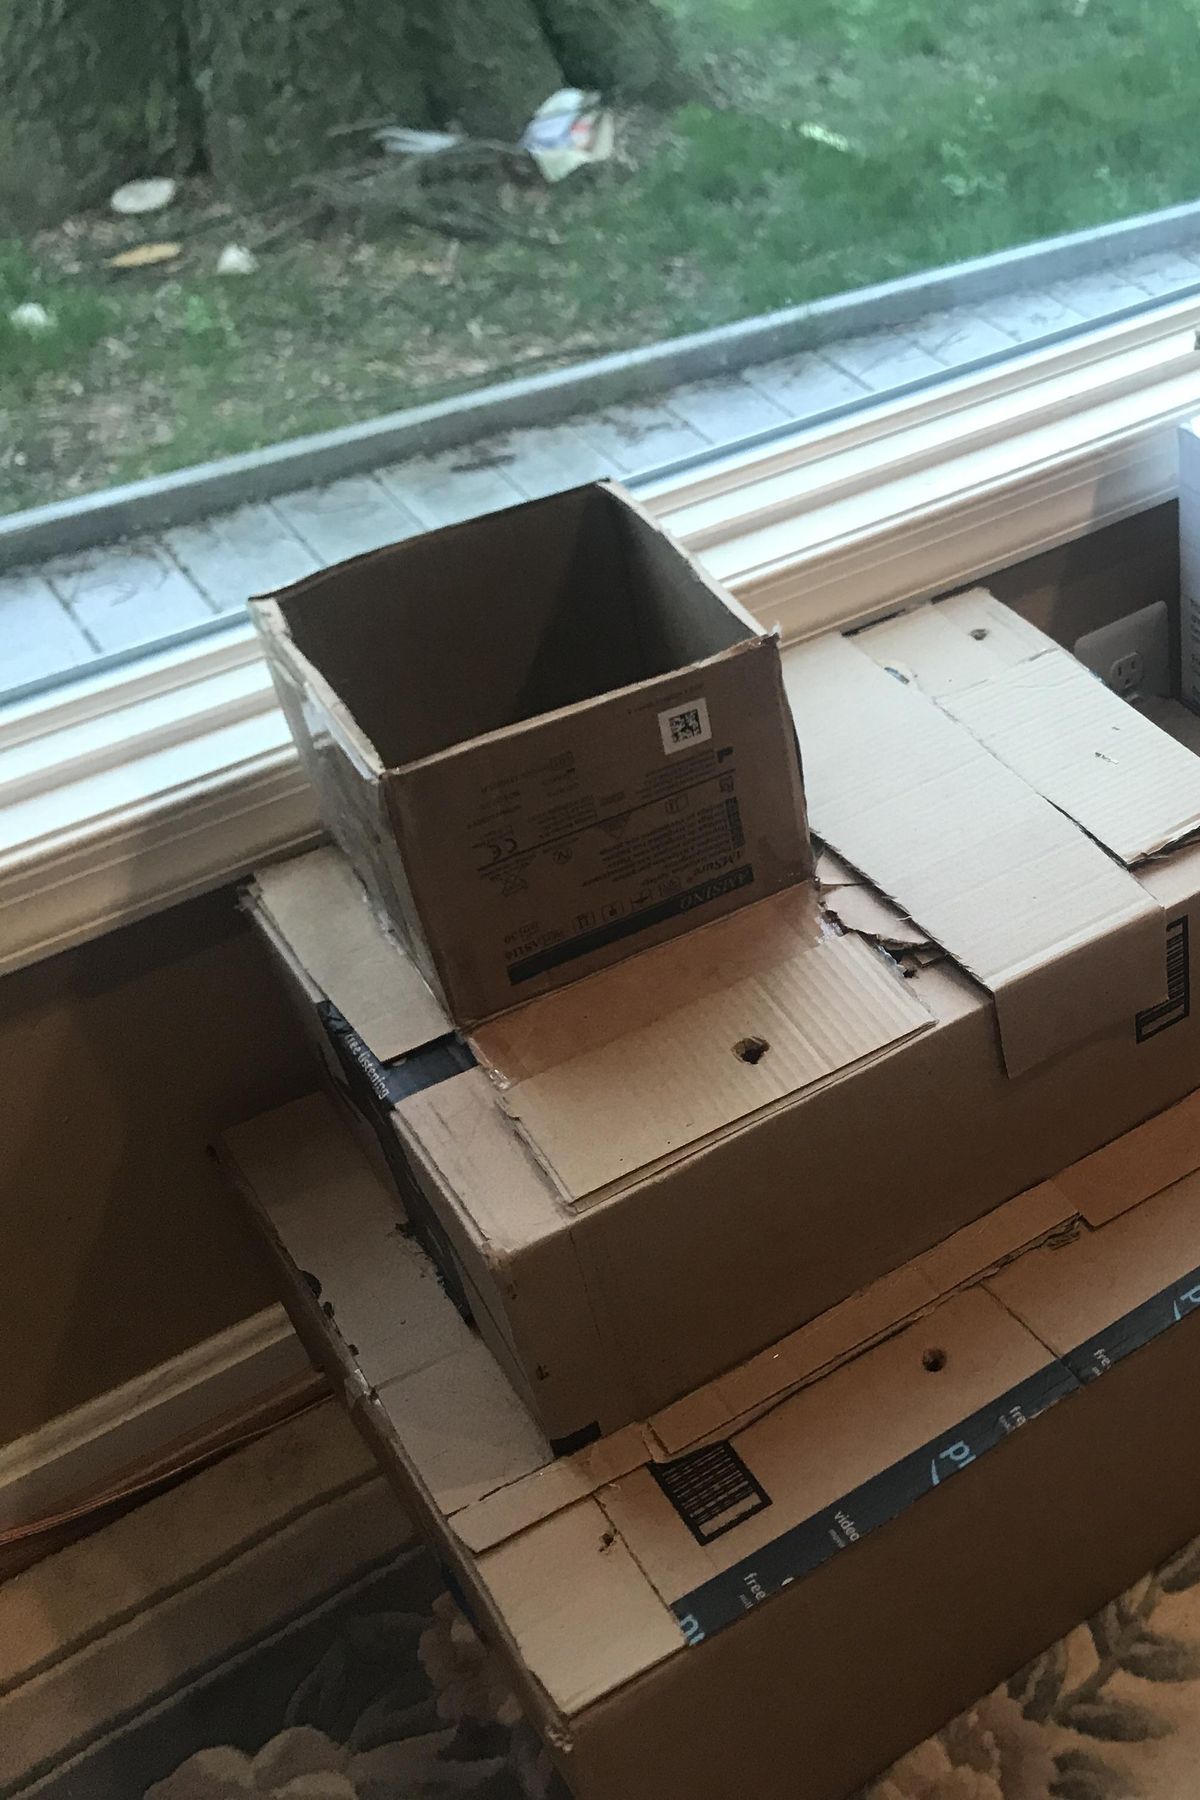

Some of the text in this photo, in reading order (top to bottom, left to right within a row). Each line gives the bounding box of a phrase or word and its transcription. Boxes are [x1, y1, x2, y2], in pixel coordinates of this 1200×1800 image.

[357, 1050, 390, 1101] listening
[833, 1510, 861, 1543] video
[743, 1572, 767, 1602] free
